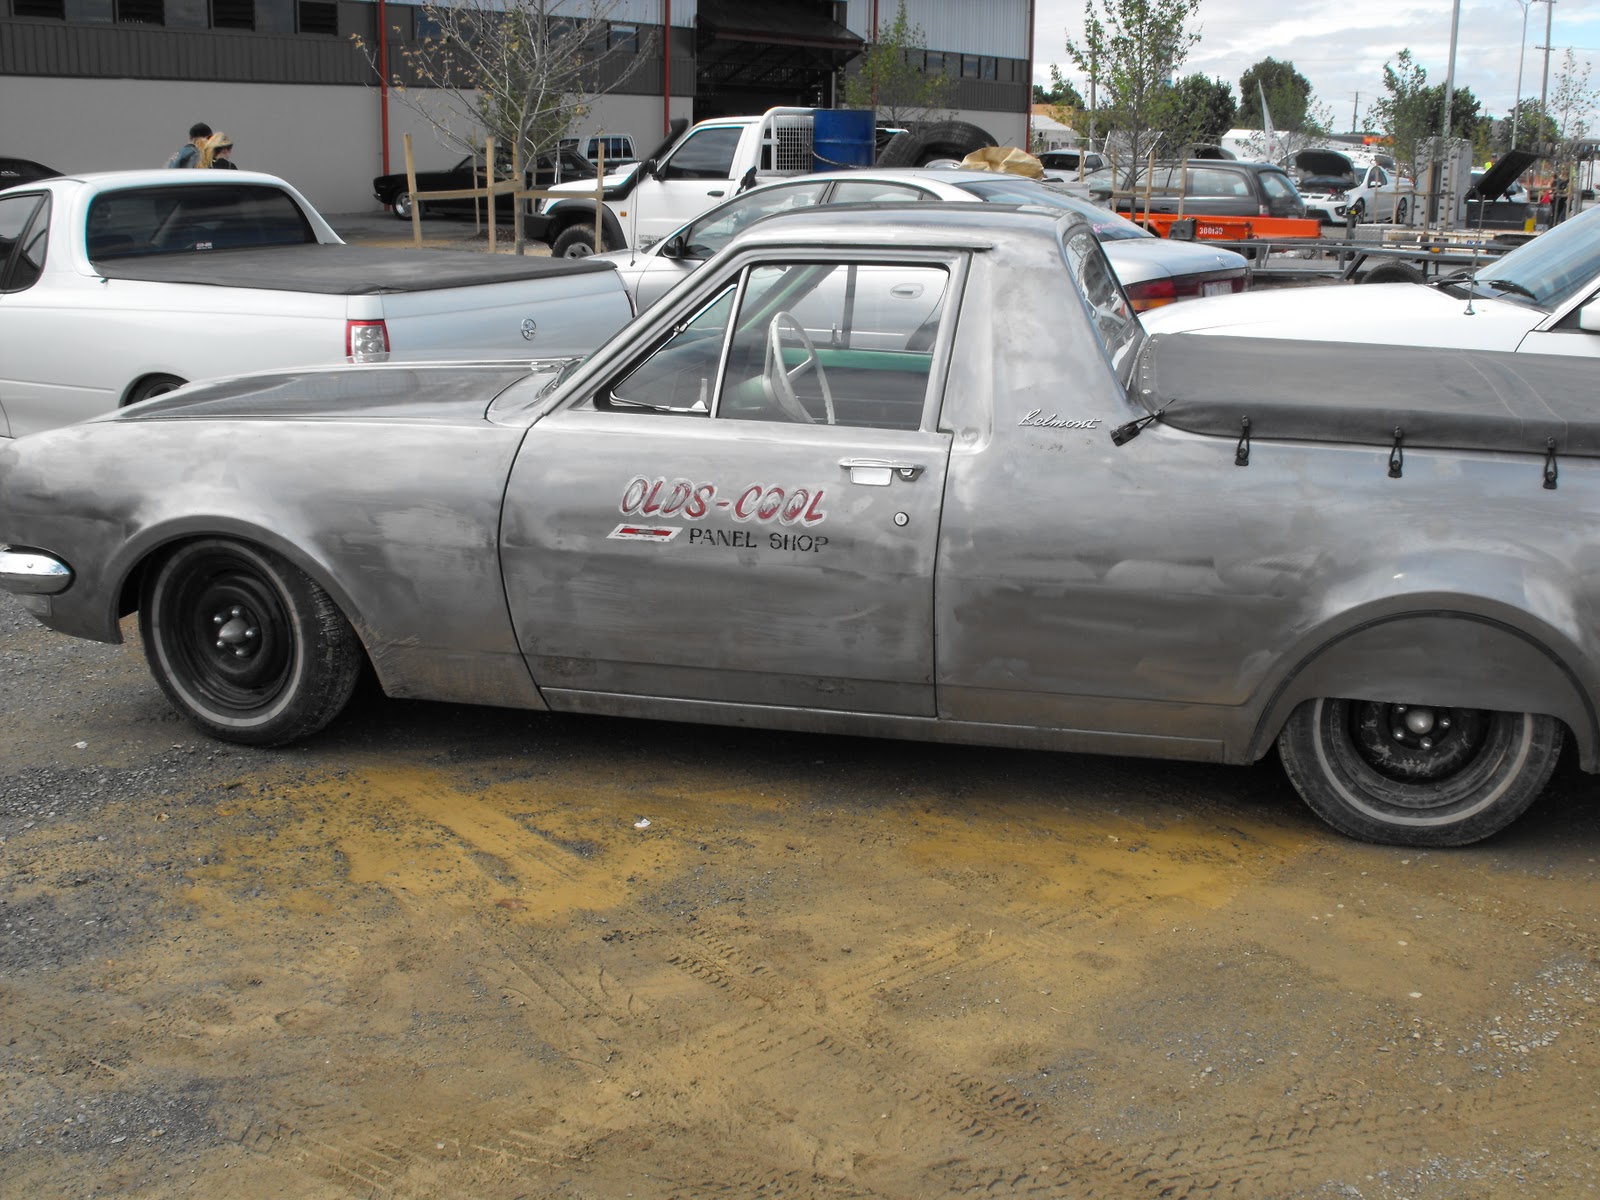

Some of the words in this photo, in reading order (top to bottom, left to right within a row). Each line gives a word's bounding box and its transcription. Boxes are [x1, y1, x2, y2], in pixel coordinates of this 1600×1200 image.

[1018, 408, 1101, 429] Belmont
[620, 476, 826, 526] OLDS-COOL
[690, 527, 757, 548] PANEL
[769, 532, 829, 553] SHOP
